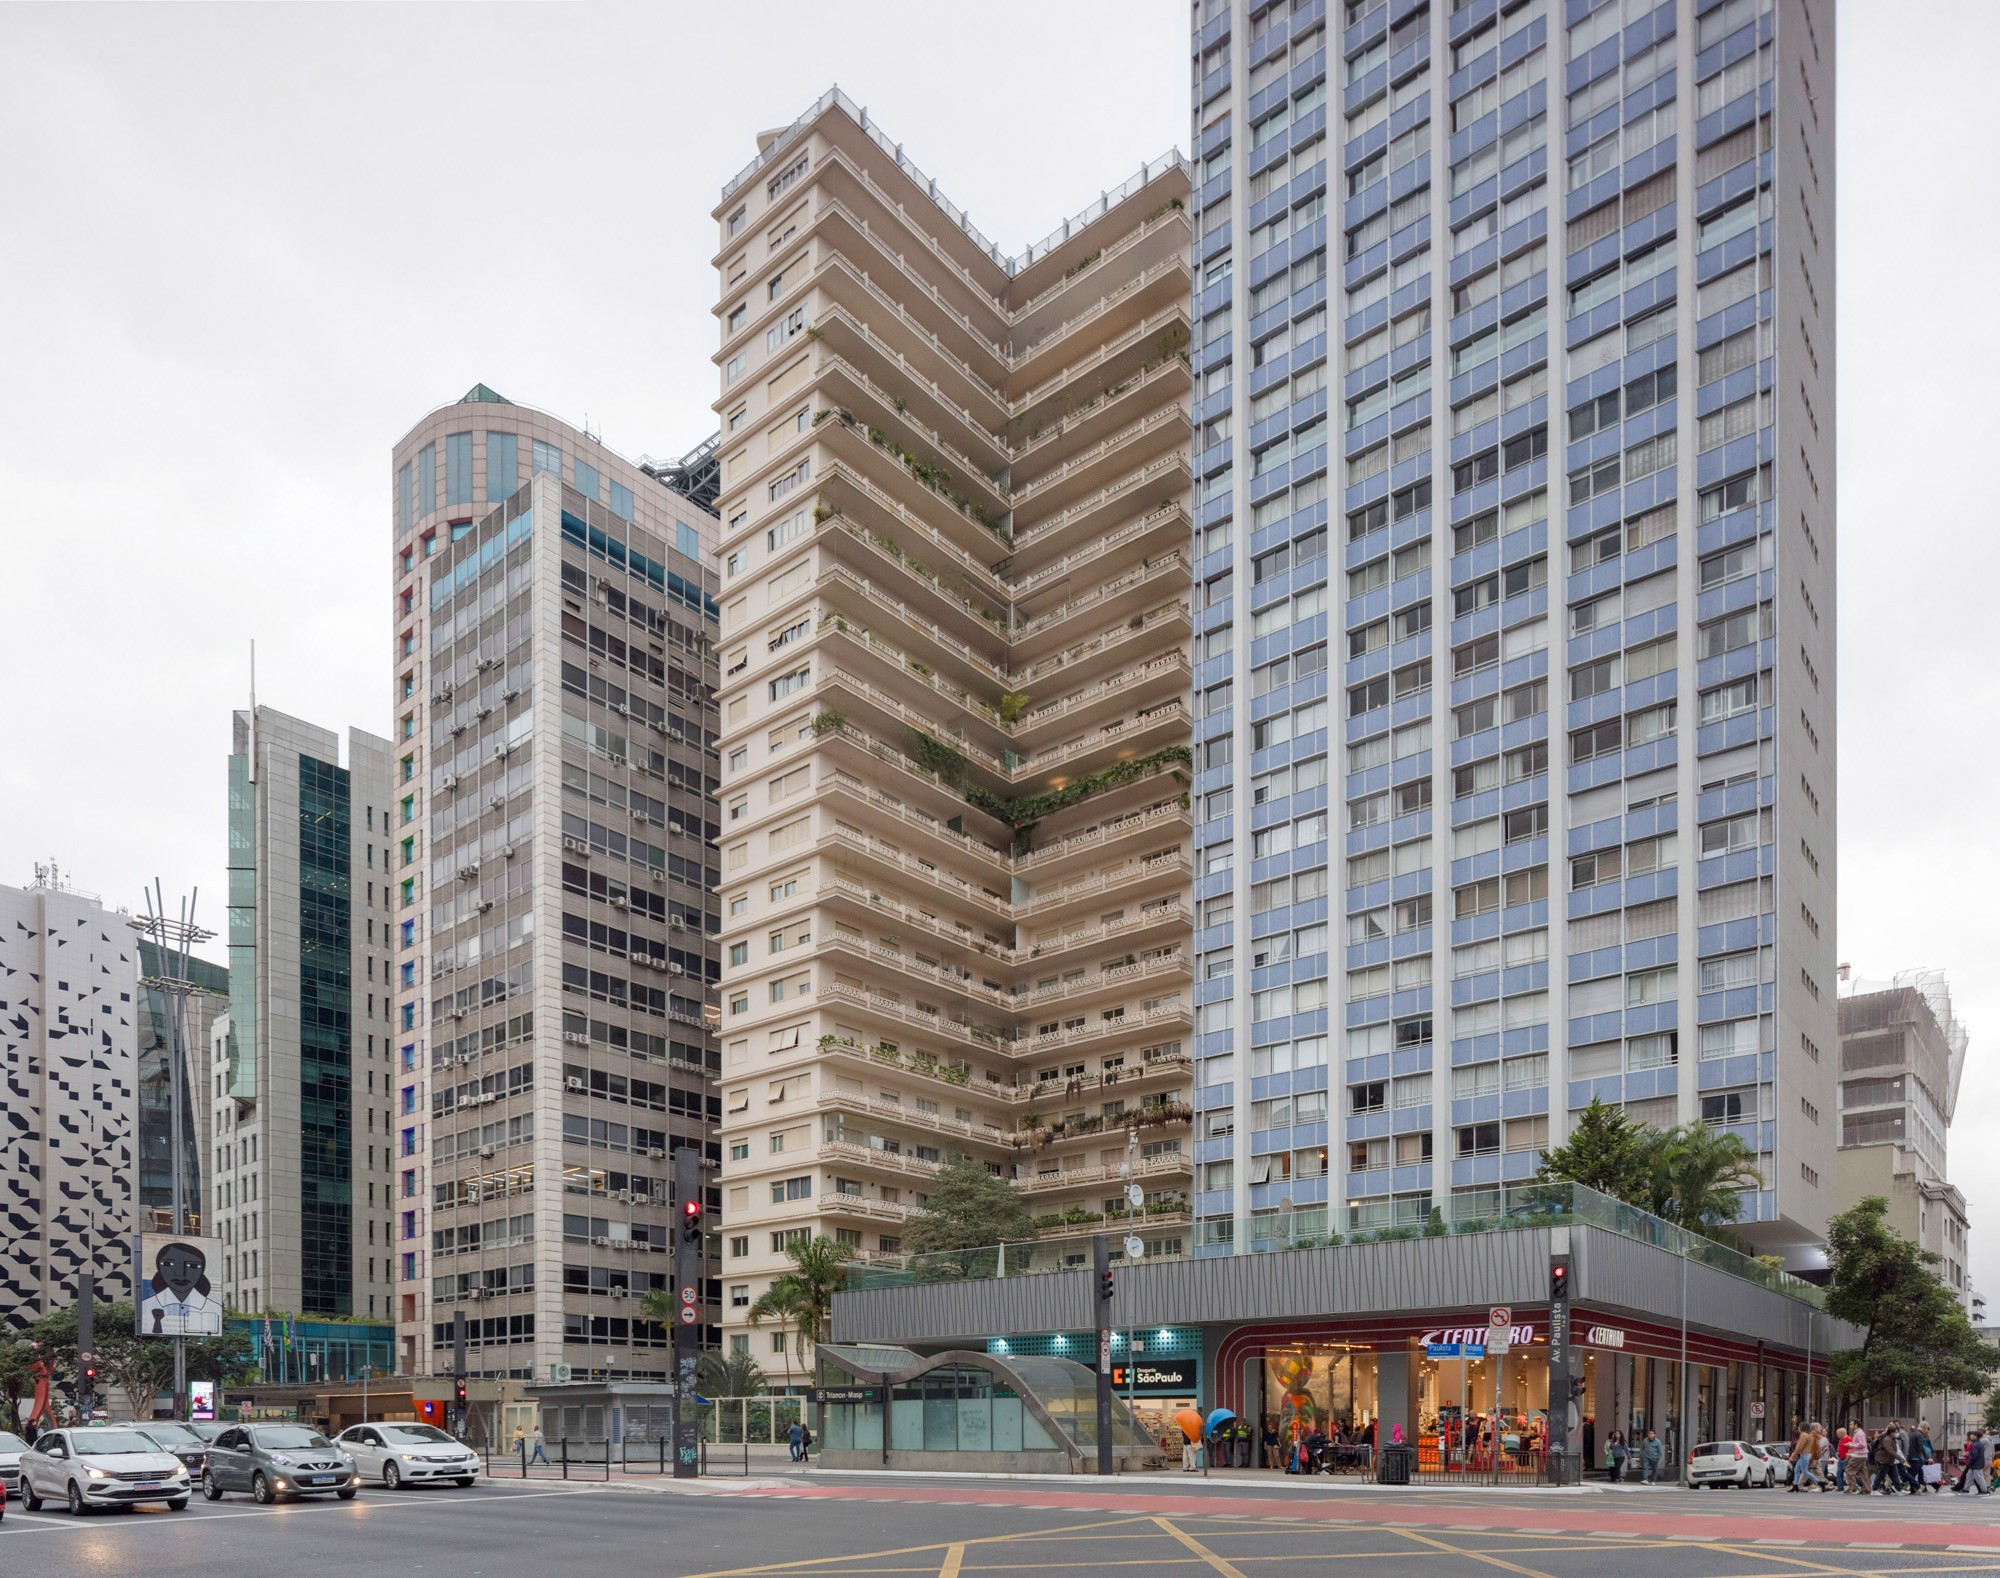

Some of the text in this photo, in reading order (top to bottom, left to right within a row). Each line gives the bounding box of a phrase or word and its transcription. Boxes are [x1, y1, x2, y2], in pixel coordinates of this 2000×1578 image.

[684, 1290, 694, 1298] 50
[1442, 1326, 1533, 1346] CENTRO
[1551, 1302, 1561, 1362] Av. Paulista
[1596, 1326, 1624, 1348] CENTAURO
[1137, 1372, 1182, 1383] SãoPaulo
